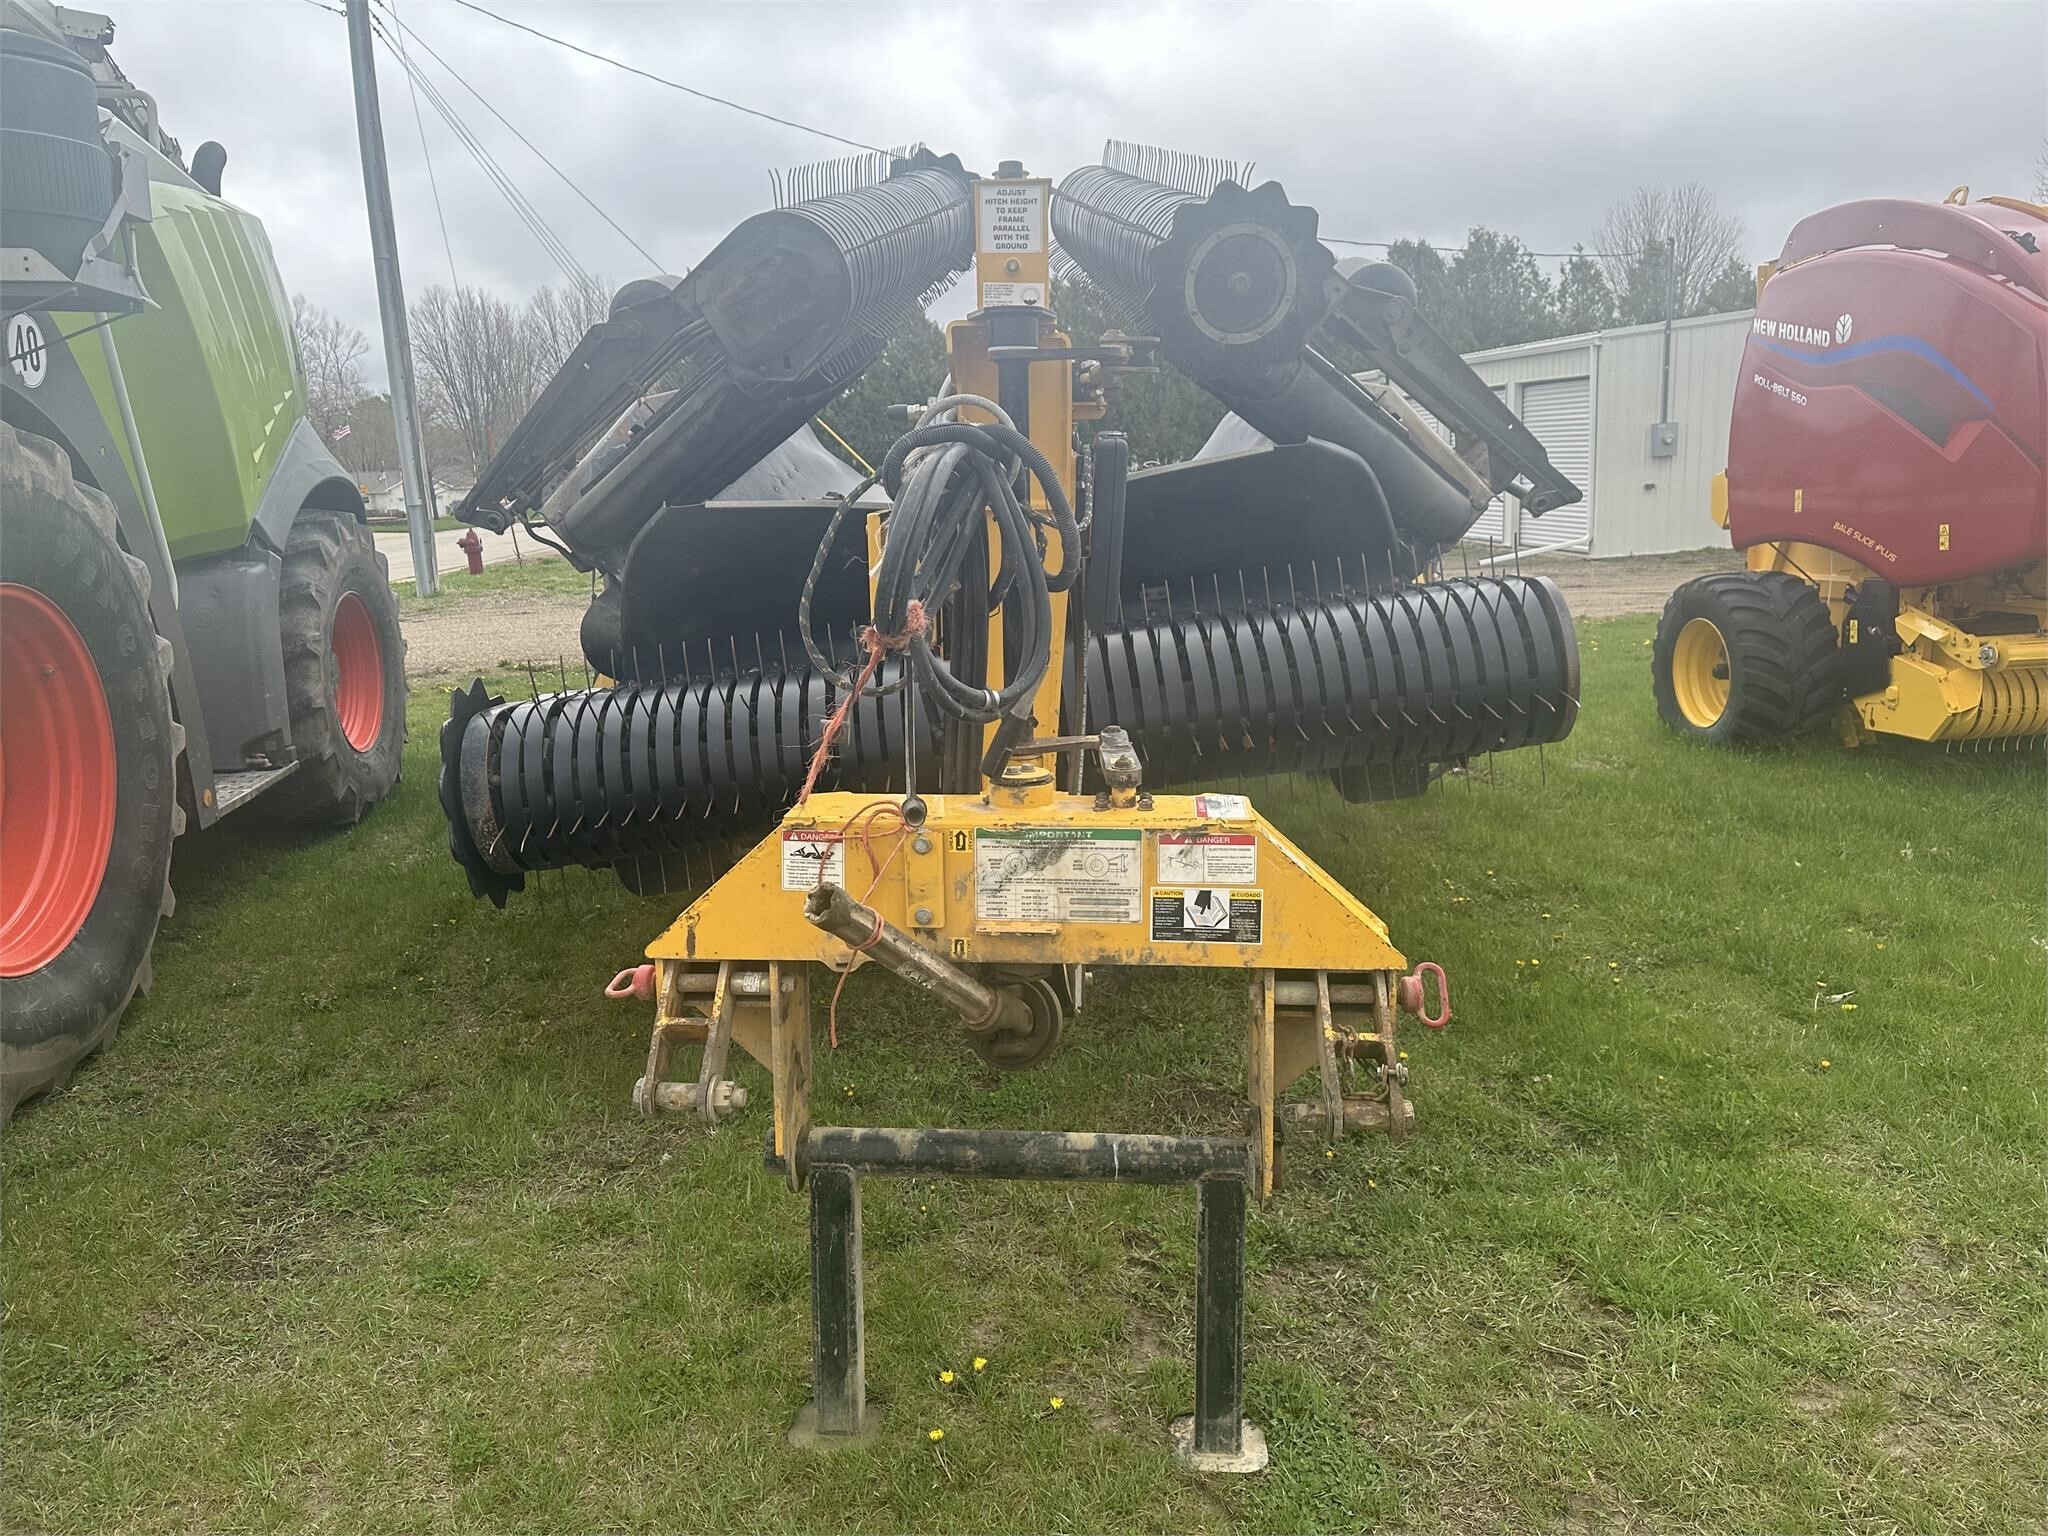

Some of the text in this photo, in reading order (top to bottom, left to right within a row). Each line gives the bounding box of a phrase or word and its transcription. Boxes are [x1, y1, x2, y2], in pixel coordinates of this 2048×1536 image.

[1753, 318, 1831, 348] NEW HOLLAND
[16, 325, 40, 372] 40
[1754, 374, 1790, 398] ROLL-BELT
[1833, 521, 1898, 562] BALE SLICE PLUS
[1196, 836, 1231, 844] DANGER
